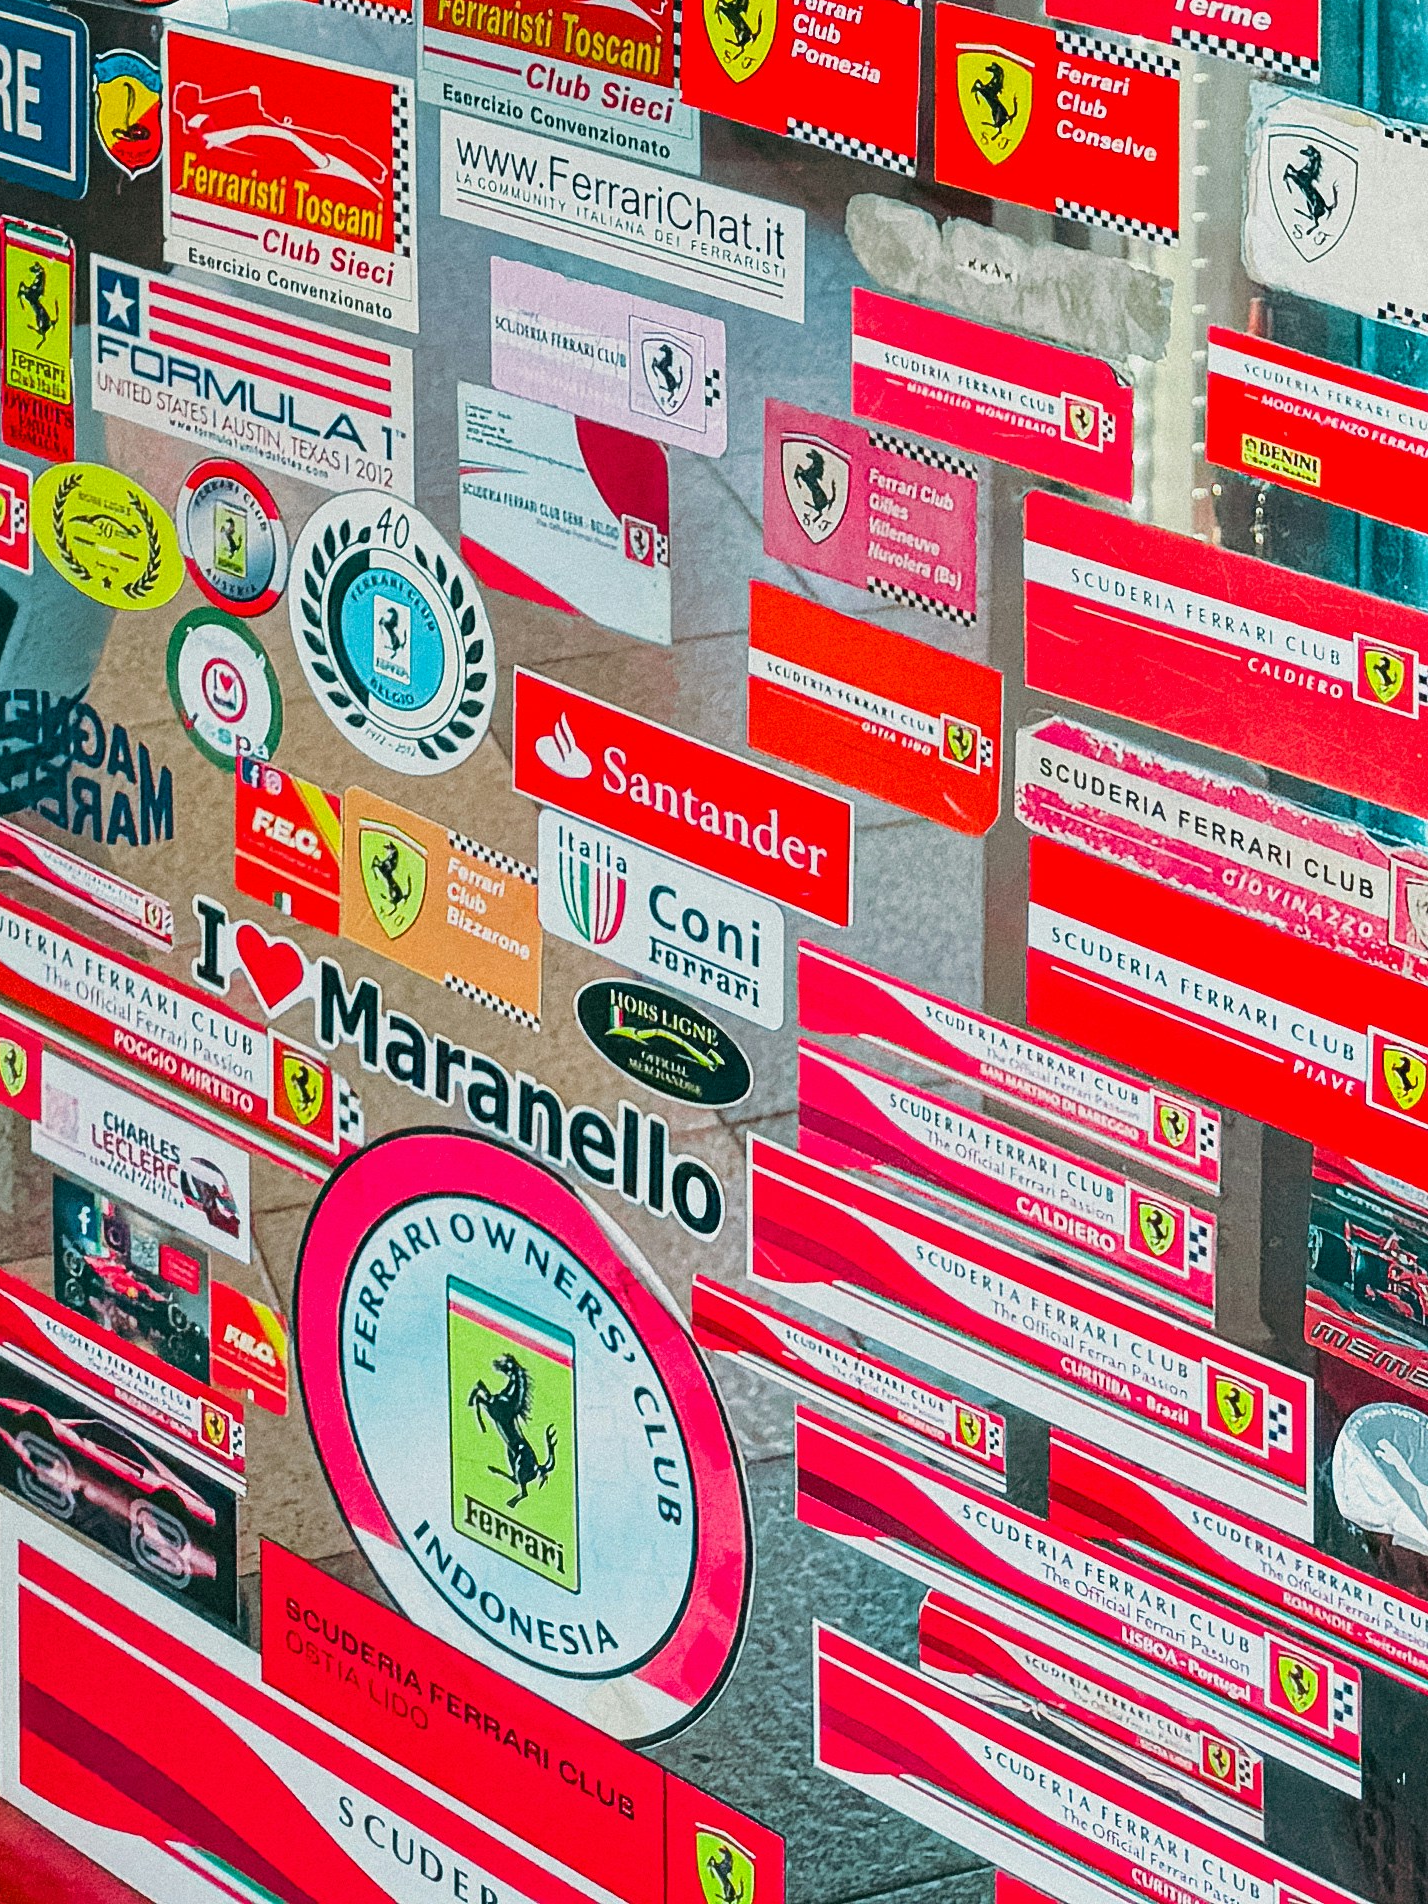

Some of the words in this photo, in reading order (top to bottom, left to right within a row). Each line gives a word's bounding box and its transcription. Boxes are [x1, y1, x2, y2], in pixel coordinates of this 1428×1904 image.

[561, 11, 663, 76] Toscani
[443, 83, 525, 120] Esercizio
[530, 104, 671, 160] Convenzionato
[525, 63, 592, 100] Club
[600, 83, 674, 125] Sieci
[456, 136, 786, 260] www.FerrariChat.it
[97, 337, 374, 442] FORMULA
[381, 425, 400, 461] 1
[1258, 438, 1320, 475] BENINI
[1071, 567, 1174, 616] SCUDERIA
[1184, 600, 1275, 647] FERRARI
[1284, 631, 1342, 667] CLUB
[1248, 657, 1344, 700] CALDIERO
[557, 823, 627, 874] Italia
[601, 745, 828, 878] Santander
[649, 884, 761, 969] Coni
[1222, 868, 1373, 939] GIOVINAZZO
[649, 936, 761, 1010] Ferrari
[192, 900, 225, 984] I
[319, 961, 725, 1242] Maranello
[1293, 1058, 1356, 1098] PIAVE
[633, 1386, 683, 1525] CLUB
[413, 1520, 619, 1652] INDONESIA
